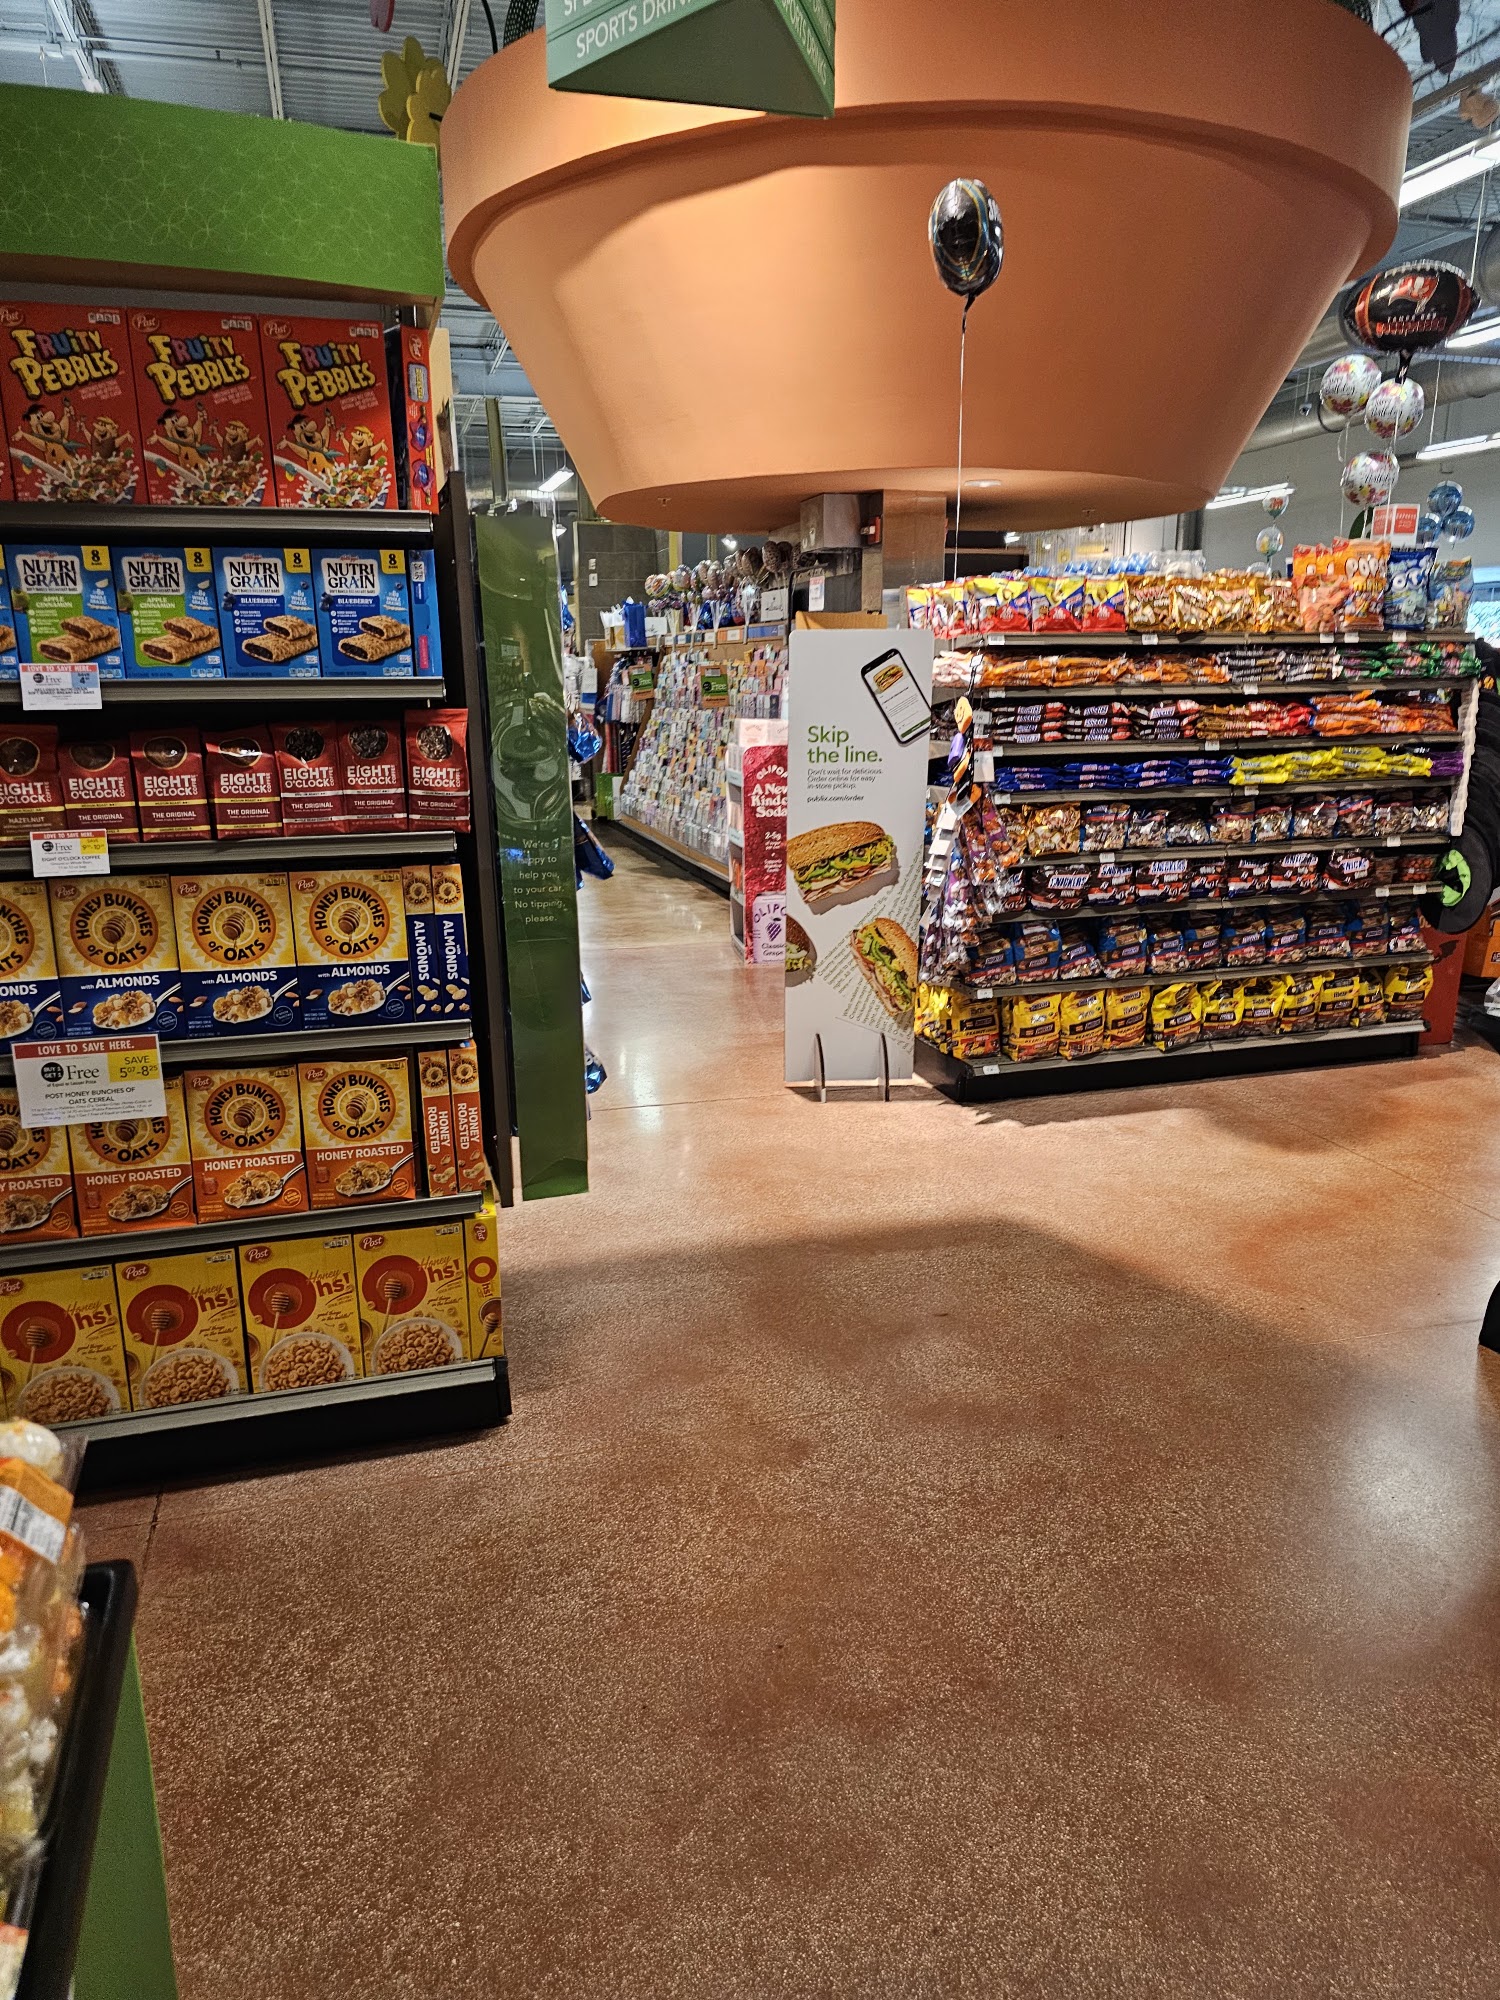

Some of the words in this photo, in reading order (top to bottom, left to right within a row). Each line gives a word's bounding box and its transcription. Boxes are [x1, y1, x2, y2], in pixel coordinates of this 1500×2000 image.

[577, 5, 638, 58] SPORTS
[10, 350, 120, 398] PEBBLES
[147, 355, 250, 402] PEBBLES
[276, 361, 377, 410] PEBBLES
[91, 550, 101, 562] 8
[194, 552, 202, 563] 8
[293, 552, 302, 564] 8
[388, 553, 397, 565] 8
[23, 559, 75, 575] NUTRI
[128, 561, 178, 576] NUTRI
[229, 562, 278, 576] NUTRI
[326, 563, 375, 577] NUTRI
[24, 572, 78, 588] GRAIN
[129, 574, 180, 588] GRAIN
[231, 575, 280, 588] GRAIN
[328, 575, 376, 589] GRAIN
[45, 675, 62, 683] Free
[711, 682, 727, 692] Free
[807, 725, 849, 747] Skip
[807, 747, 840, 763] the
[844, 745, 883, 763] line.
[283, 767, 328, 780] EIGHT
[347, 765, 391, 777] EIGHT
[412, 766, 455, 779] EIGHT
[69, 776, 119, 790] EIGHT
[143, 775, 191, 789] EIGHT
[220, 772, 267, 787] EIGHT
[285, 778, 330, 788] O'CLOCK
[348, 775, 392, 786] O'CLOCK
[413, 777, 456, 787] O'CLOCK
[807, 775, 828, 783] Order
[71, 789, 120, 799] O'CLOCK
[145, 787, 193, 797] O'CLOCK
[221, 784, 268, 794] O'CLOCK
[752, 784, 763, 795] A
[751, 795, 781, 807] Kind
[756, 806, 788, 818] Soda
[55, 843, 73, 851] Free
[523, 839, 550, 849] We're
[519, 871, 539, 880] help
[1050, 875, 1088, 888] SNICKERS
[57, 887, 75, 897] Post
[179, 884, 197, 894] Post
[298, 880, 314, 891] Post
[525, 887, 546, 895] your
[198, 894, 222, 935] HONEY
[224, 891, 272, 933] BUNCHES
[314, 888, 339, 930] HONEY
[342, 887, 385, 928] BUNCHES
[76, 895, 101, 940] HONEY
[103, 893, 153, 936] BUNCHES
[525, 914, 558, 925] please.
[224, 938, 266, 961] OATS
[339, 933, 380, 955] OATS
[413, 920, 430, 981] ALMONDS
[443, 920, 458, 980] ALMONDS
[103, 942, 147, 965] OATS
[216, 970, 277, 984] ALMONDS
[331, 965, 391, 977] ALMONDS
[96, 975, 160, 989] ALMONDS
[38, 1045, 61, 1055] LOVE
[66, 1044, 77, 1054] TO
[82, 1042, 105, 1053] SAVE
[109, 1040, 134, 1051] HERE.
[67, 1065, 100, 1080] Free
[124, 1056, 149, 1064] SAVE
[308, 1070, 324, 1080] Post
[193, 1078, 209, 1088] Post
[65, 1090, 90, 1098] HONEY
[91, 1088, 124, 1096] BUNCHES
[88, 1096, 115, 1104] CEREAL
[323, 1075, 347, 1116] HONEY
[349, 1074, 391, 1113] BUNCHES
[209, 1085, 234, 1125] HONEY
[236, 1083, 280, 1121] BUNCHES
[346, 1118, 386, 1138] OATS
[427, 1106, 440, 1154] ROASTED
[438, 1110, 451, 1147] HONEY
[458, 1102, 469, 1150] ROASTED
[468, 1106, 480, 1143] HONEY
[235, 1125, 275, 1148] OATS
[118, 1139, 160, 1162] OATS
[317, 1150, 353, 1161] HONEY
[356, 1145, 404, 1158] ROASTED
[204, 1160, 244, 1172] HONEY
[245, 1154, 295, 1167] ROASTED
[9, 1177, 63, 1190] ROASTED
[86, 1173, 125, 1186] HONEY
[129, 1167, 182, 1181] ROASTED
[362, 1235, 383, 1248] Post
[248, 1248, 269, 1259] Post
[126, 1266, 147, 1277] Post
